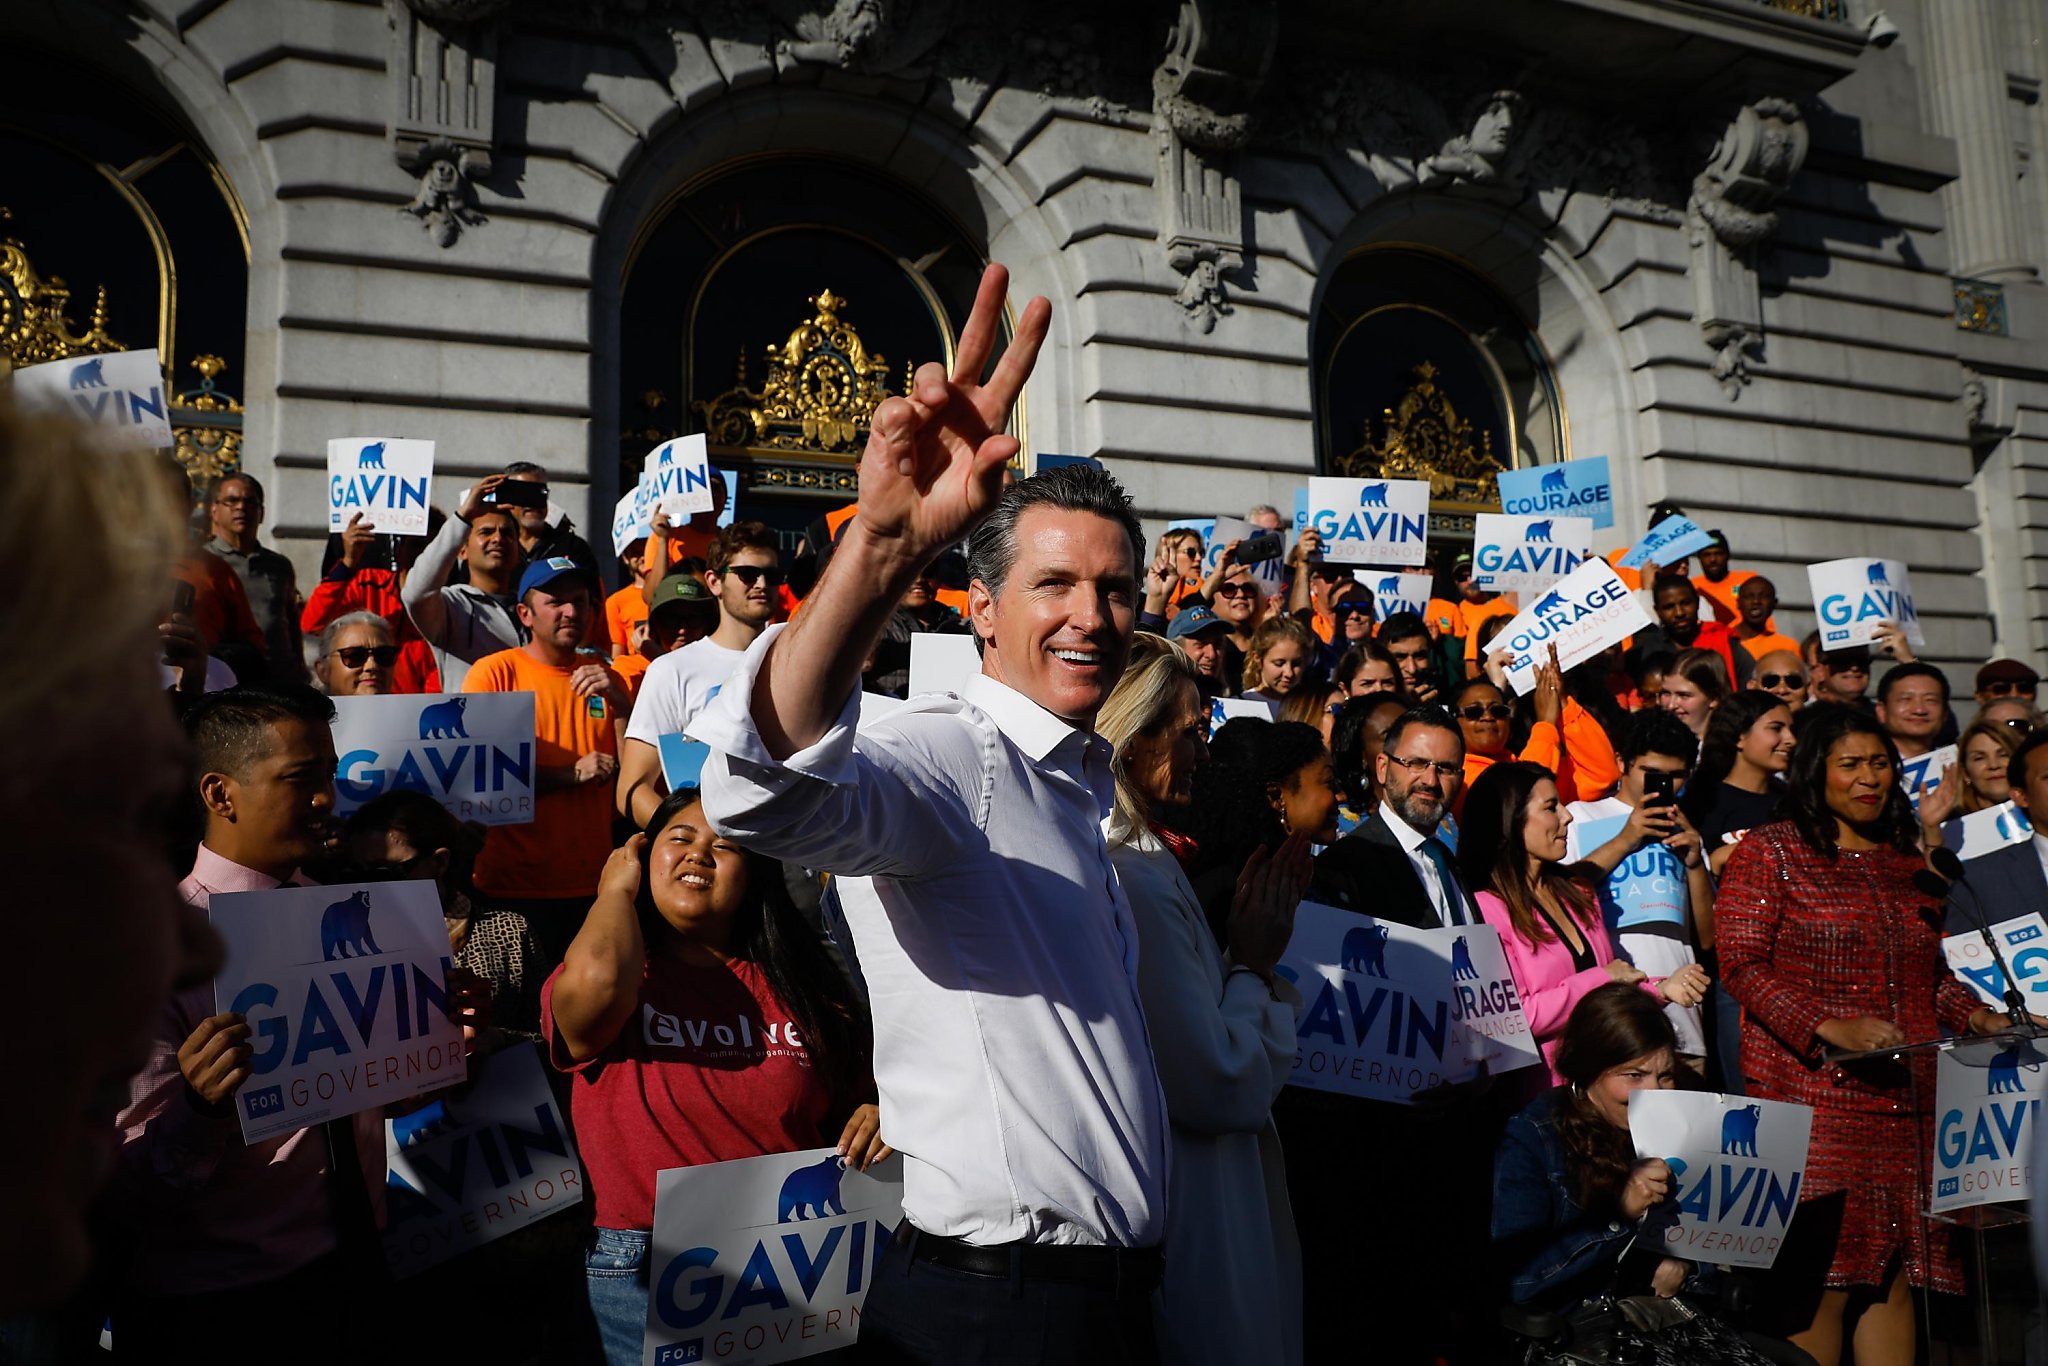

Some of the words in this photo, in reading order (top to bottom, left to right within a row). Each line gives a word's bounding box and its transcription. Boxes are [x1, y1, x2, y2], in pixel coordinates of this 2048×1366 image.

[74, 386, 165, 425] VIN
[331, 474, 427, 510] GAVIN
[641, 464, 707, 506] GAVIN
[1505, 484, 1609, 515] COURAGE
[1313, 509, 1425, 543] GAVIN
[1334, 545, 1423, 558] GOVERNOR
[1477, 544, 1589, 575] GAVIN
[1509, 578, 1627, 653] OURAGE
[1821, 589, 1916, 625] GAVIN
[336, 742, 530, 802] GAVIN
[230, 956, 455, 1075] GAVIN
[1275, 965, 1447, 1063] AVIN
[1451, 979, 1521, 1022] URAGE
[250, 1093, 279, 1112] FOR
[291, 1041, 462, 1107] GOVERNOR
[1939, 1100, 2040, 1169] GAV
[385, 1103, 569, 1234] AVIN
[1941, 1181, 1957, 1192] FOR
[662, 1345, 697, 1363] FOR
